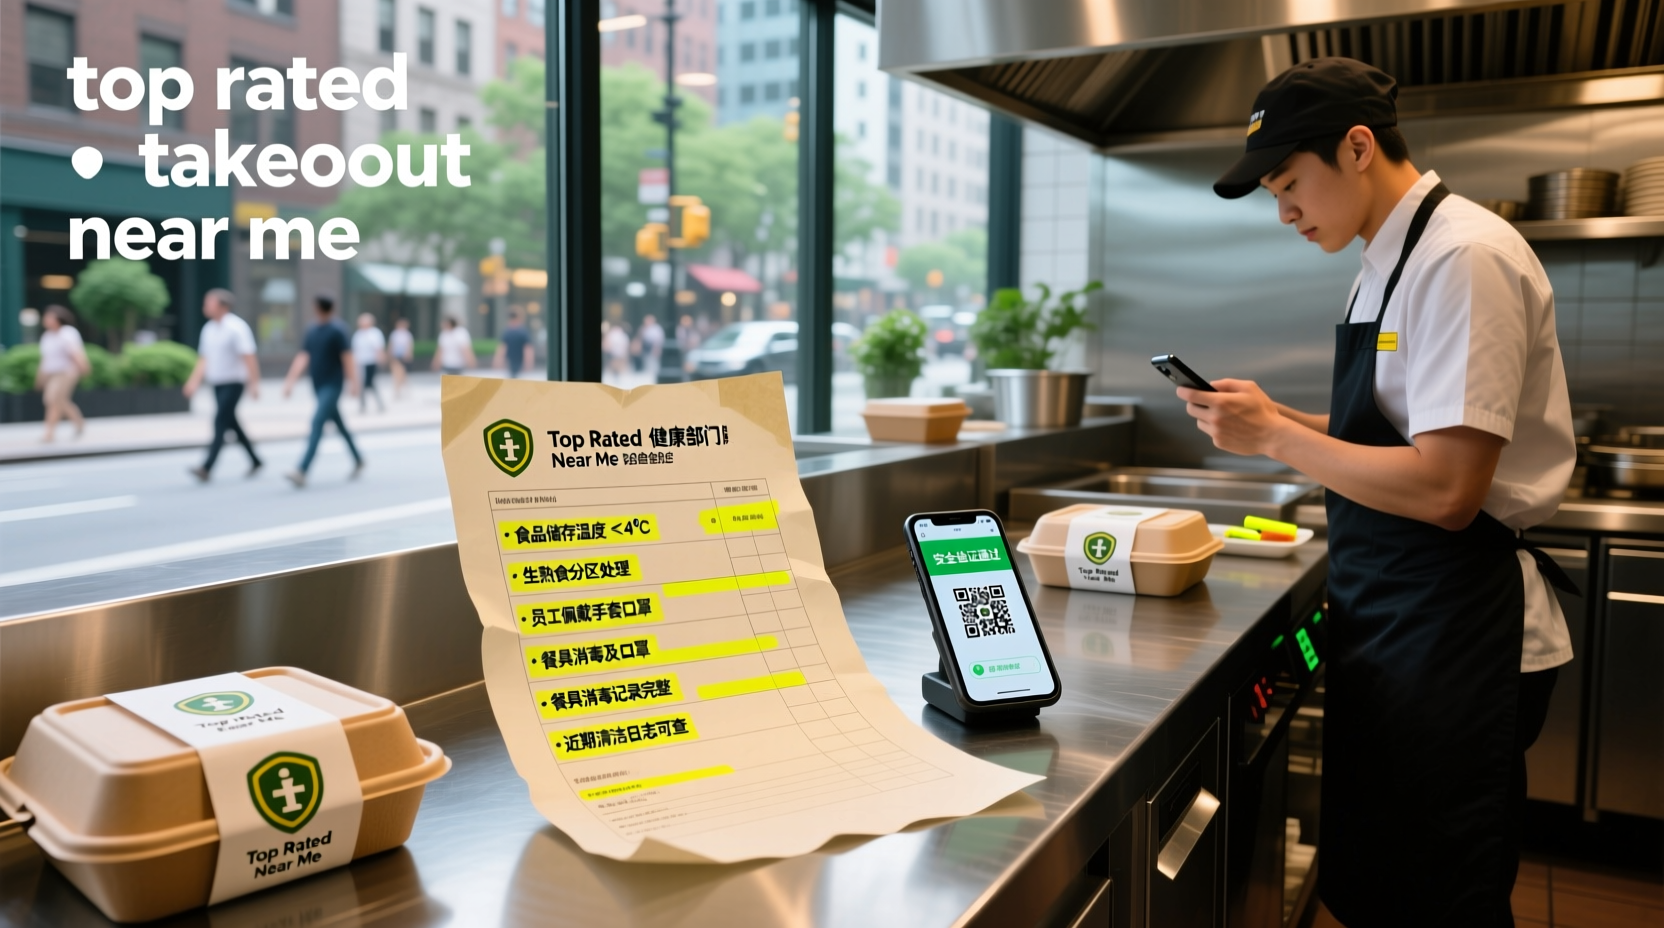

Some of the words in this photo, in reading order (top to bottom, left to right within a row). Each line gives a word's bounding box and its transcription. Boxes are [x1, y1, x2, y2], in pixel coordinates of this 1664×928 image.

[547, 430, 585, 452] Top
[589, 428, 643, 448] Rated
[552, 452, 592, 468] Near
[595, 451, 618, 467] Me
[247, 848, 278, 865] Top
[283, 830, 332, 856] Rated
[254, 861, 294, 879] Near
[297, 851, 322, 868] Me
